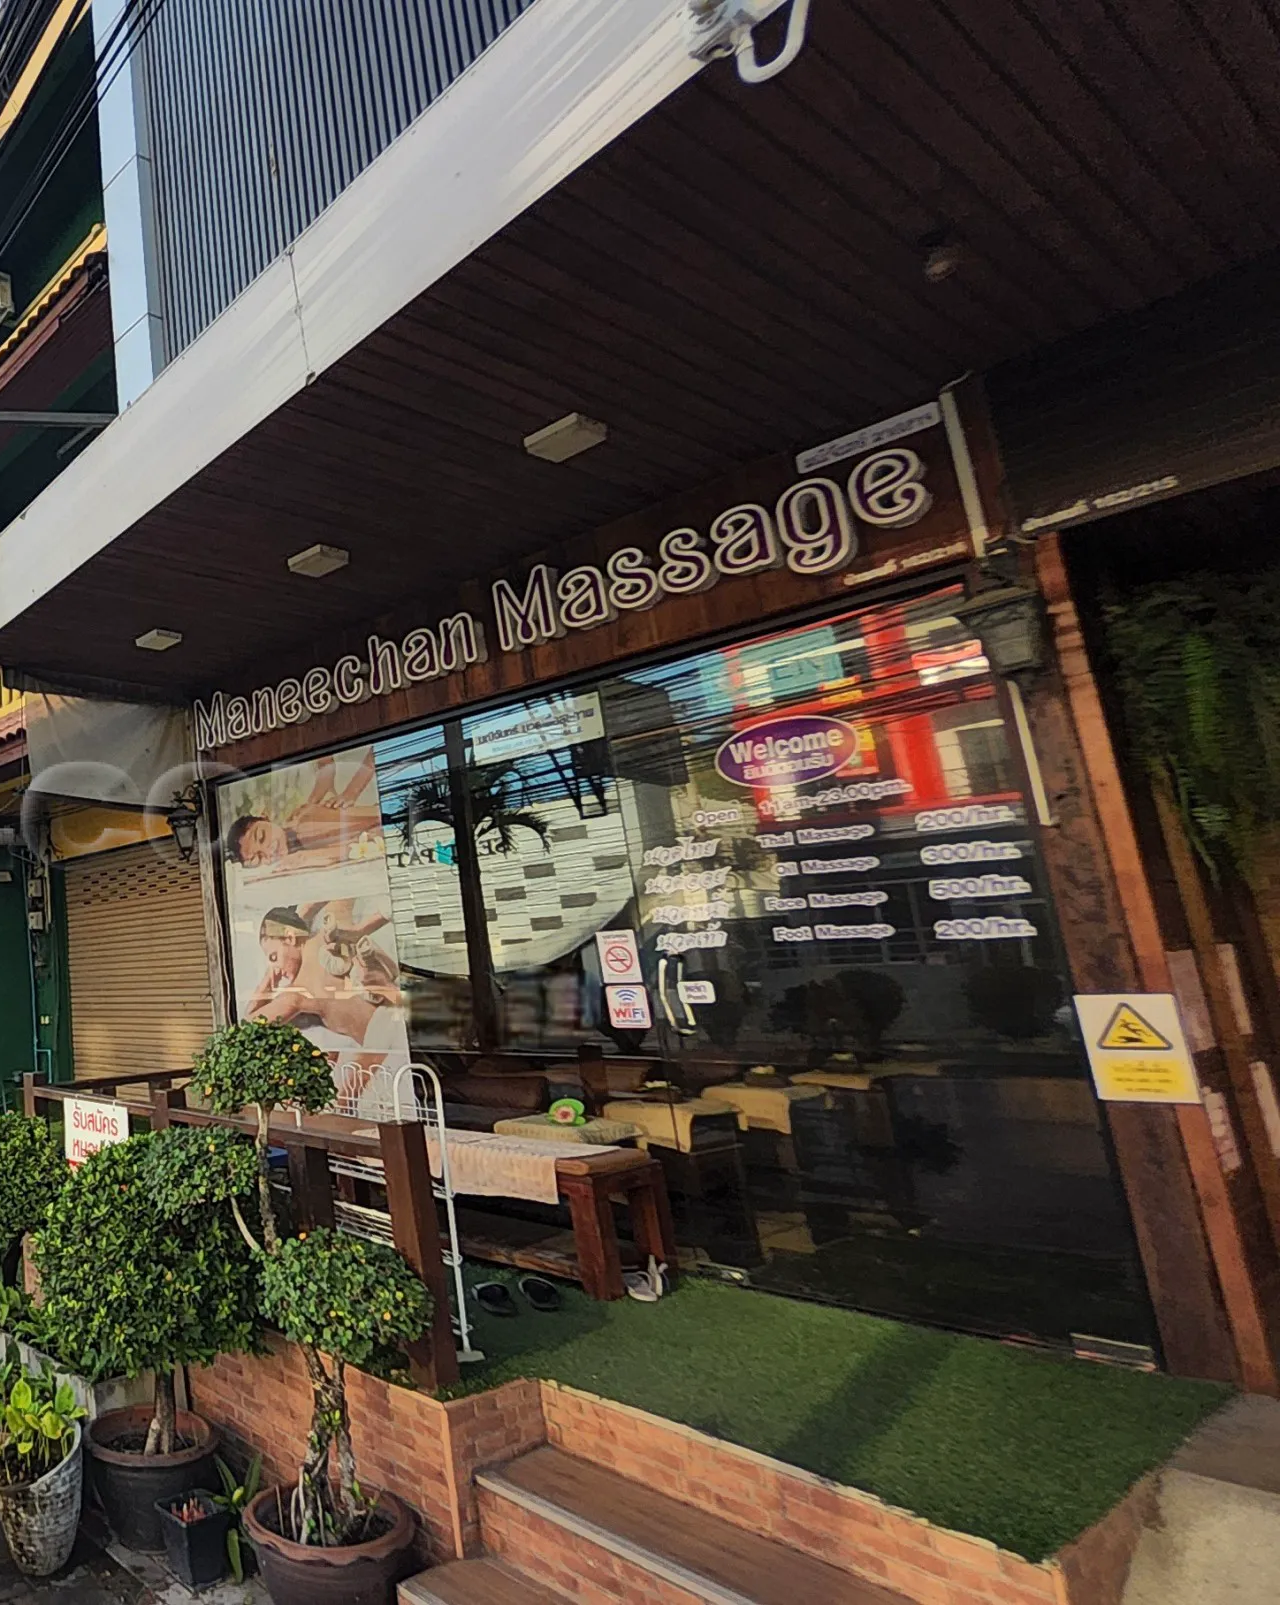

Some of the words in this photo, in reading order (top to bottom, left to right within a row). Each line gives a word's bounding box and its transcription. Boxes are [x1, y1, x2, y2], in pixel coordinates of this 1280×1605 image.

[193, 612, 478, 751] Maneechan
[491, 448, 928, 651] Massage
[728, 727, 845, 765] Welcome
[694, 809, 739, 826] Open
[798, 825, 870, 842] Massage
[802, 857, 876, 871] Massage
[766, 897, 805, 909] Face
[810, 892, 884, 906] Massage
[774, 928, 810, 940] Foot
[817, 925, 891, 938] Massage
[72, 1101, 118, 1137] รับสมัคร
